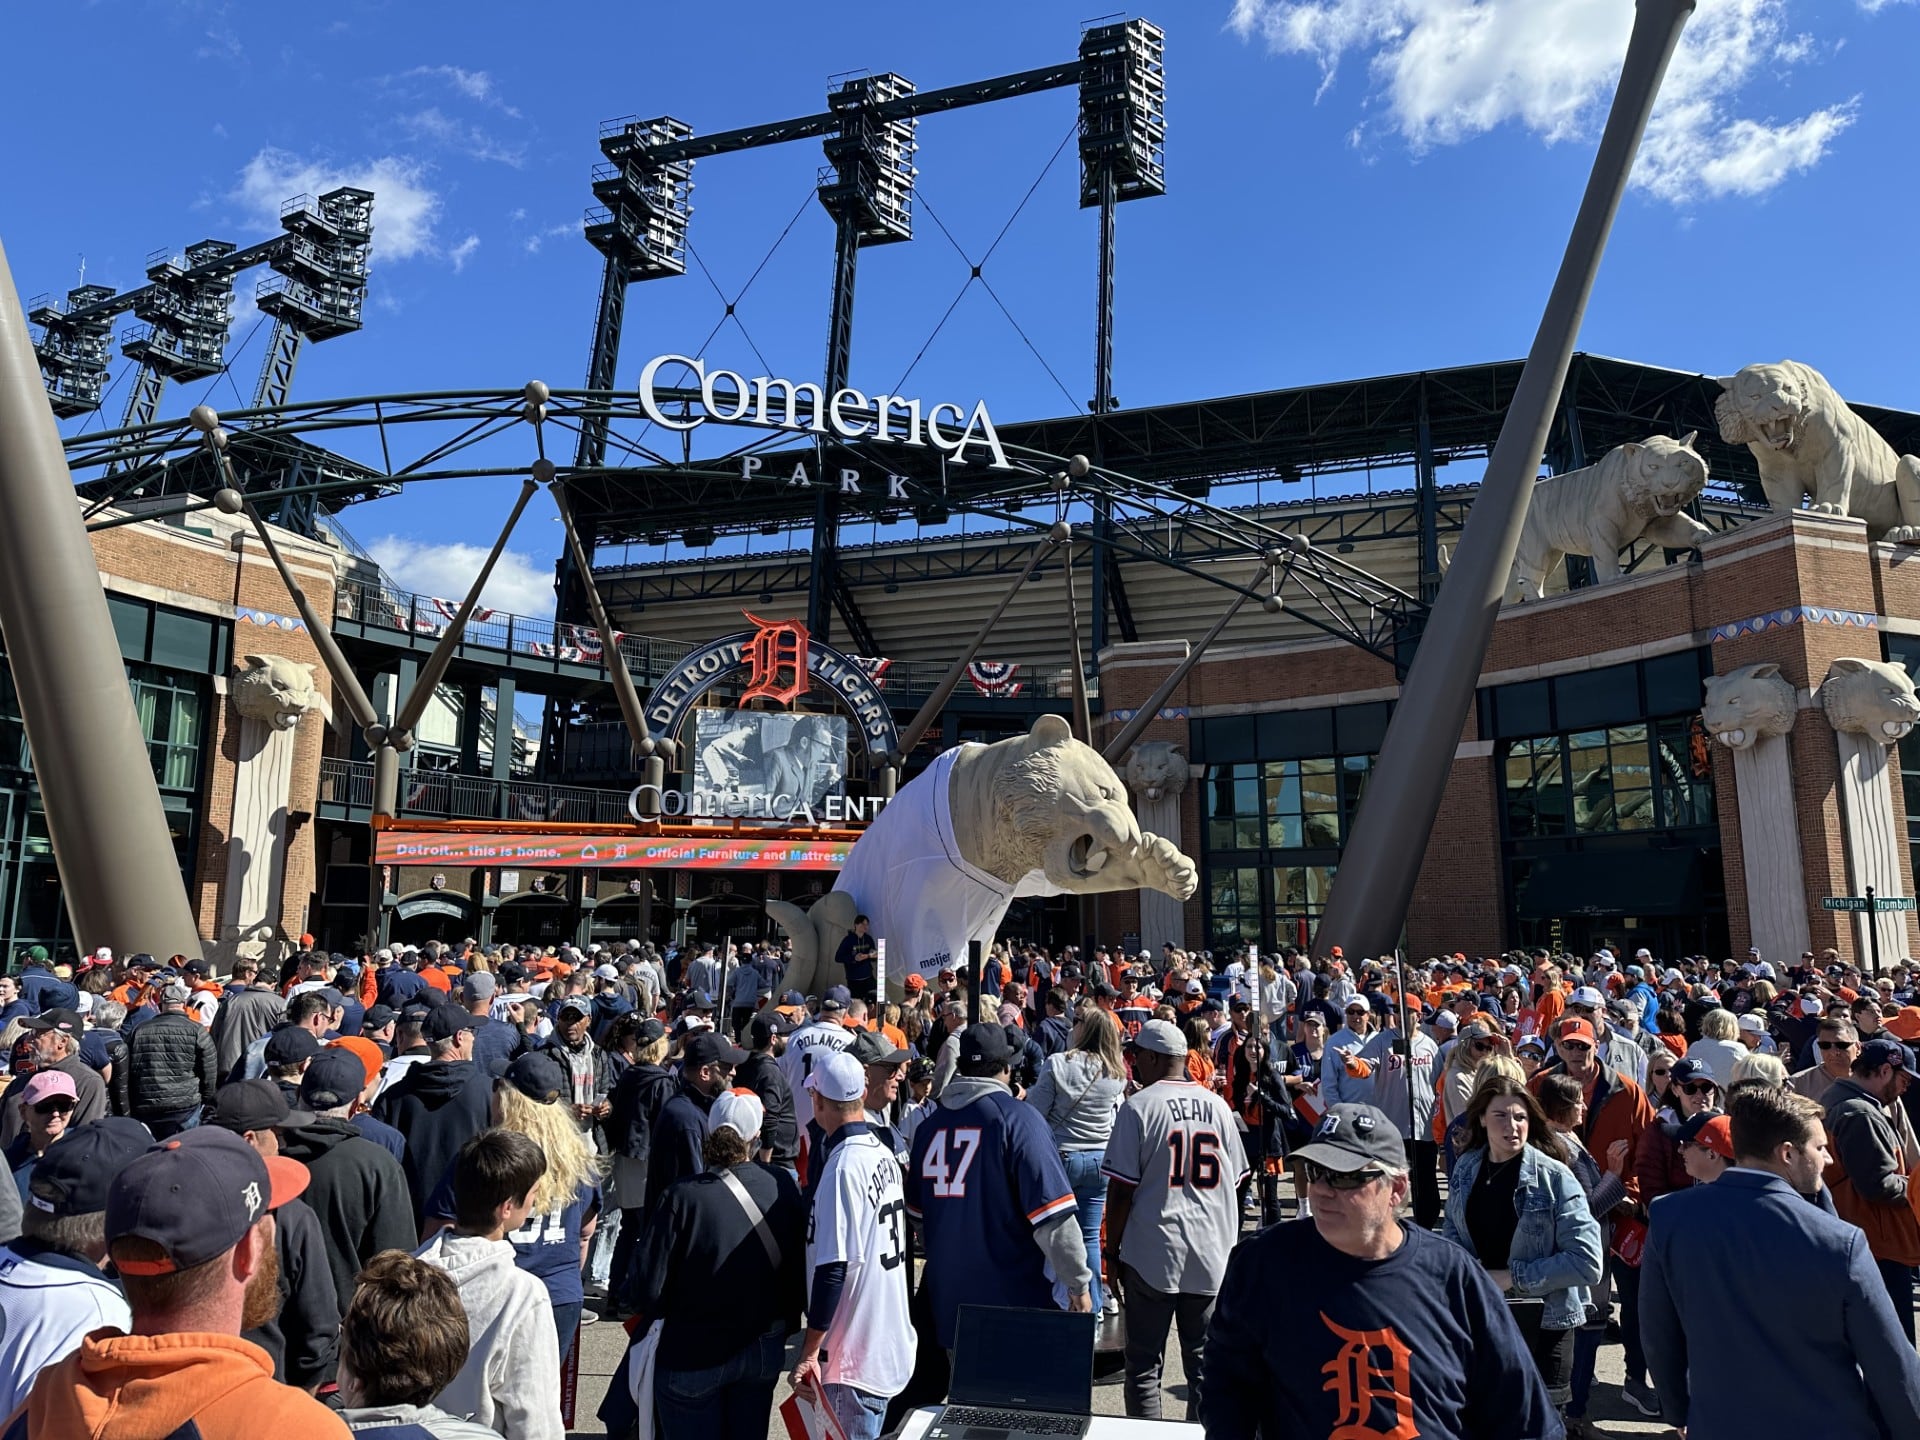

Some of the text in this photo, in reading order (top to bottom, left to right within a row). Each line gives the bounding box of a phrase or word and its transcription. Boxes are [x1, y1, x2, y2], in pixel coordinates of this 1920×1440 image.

[742, 455, 909, 500] PARK
[651, 642, 889, 738] DETROIT TIGERS
[468, 845, 496, 857] this
[500, 846, 512, 857] is
[516, 847, 561, 858] home.
[646, 847, 845, 862] Official Furniture and Mattress
[1825, 898, 1865, 909] Michigan
[1876, 899, 1914, 909] Trumbull
[919, 952, 951, 969] meijer
[1166, 1097, 1213, 1125] BEAN
[922, 1126, 983, 1198] 47
[1167, 1129, 1221, 1190] 16
